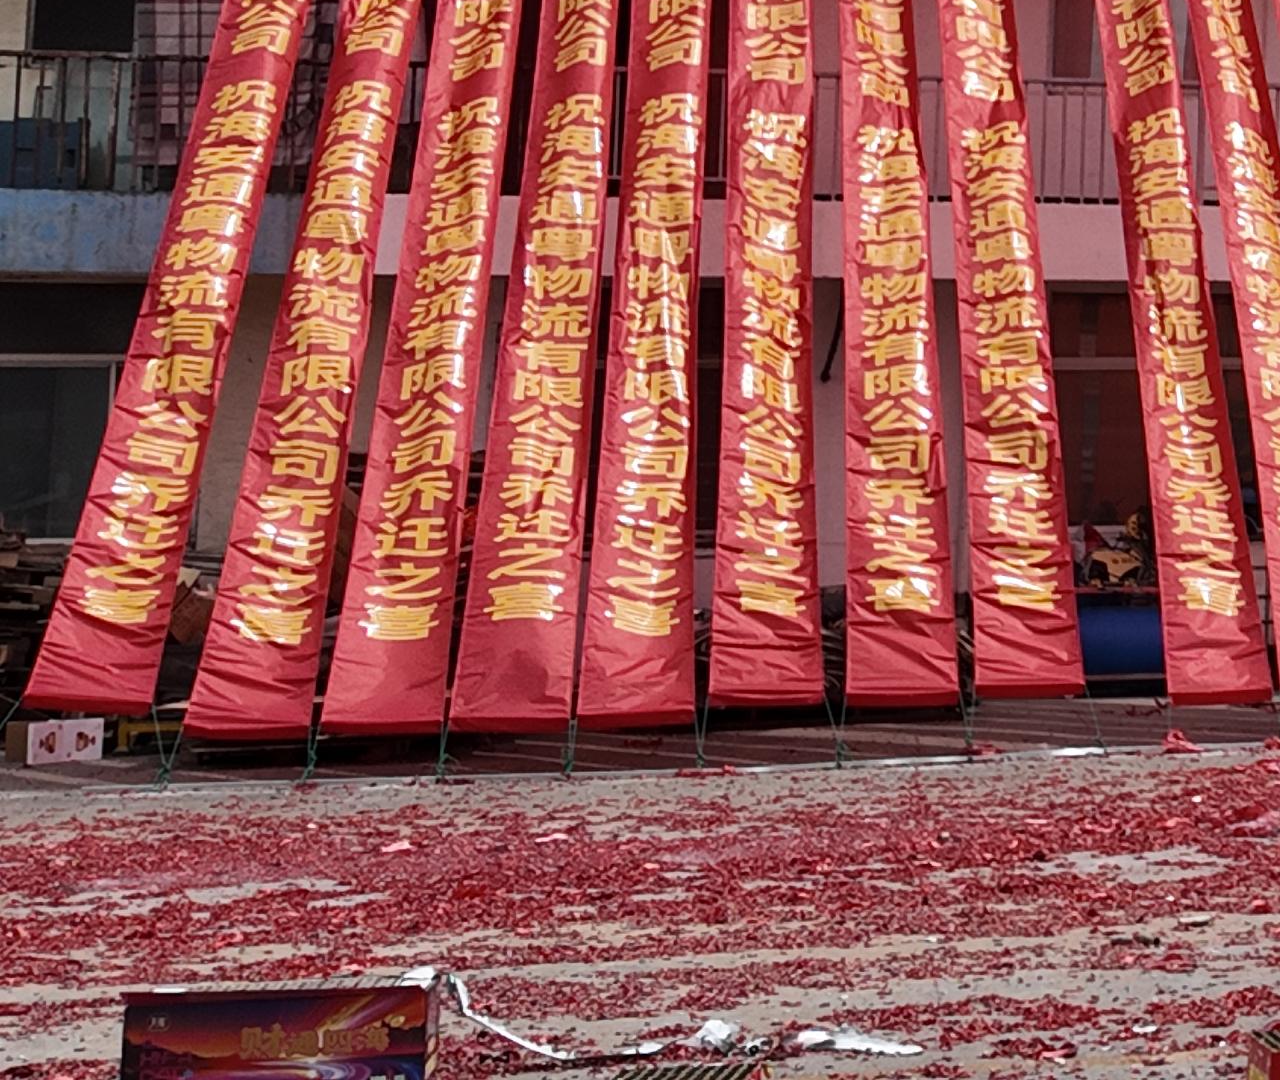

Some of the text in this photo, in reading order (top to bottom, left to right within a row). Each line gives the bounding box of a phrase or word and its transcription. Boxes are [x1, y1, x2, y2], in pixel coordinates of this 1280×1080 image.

[85, 81, 277, 624] 祝海安通粤物流有限公司乔迁之喜
[241, 82, 392, 645] 祝海安通粤物流有限公司乔迁之喜
[369, 98, 498, 641] 祝海安通粤物流有限公司乔迁之喜
[488, 96, 605, 621] 祝海安通粤物流有限公司乔迁之喜
[613, 95, 702, 637] 祝海安通粤物流有限公司乔迁之喜
[737, 111, 807, 617] 祝海安通粤物流有限公司乔迁之喜
[861, 127, 936, 612] 祝海安通粤物流有限公司乔迁之喜
[966, 122, 1056, 610] 祝海安通粤物流有限公司乔迁之喜
[1130, 110, 1243, 616] 祝海安通粤物流有限公司乔迁之喜
